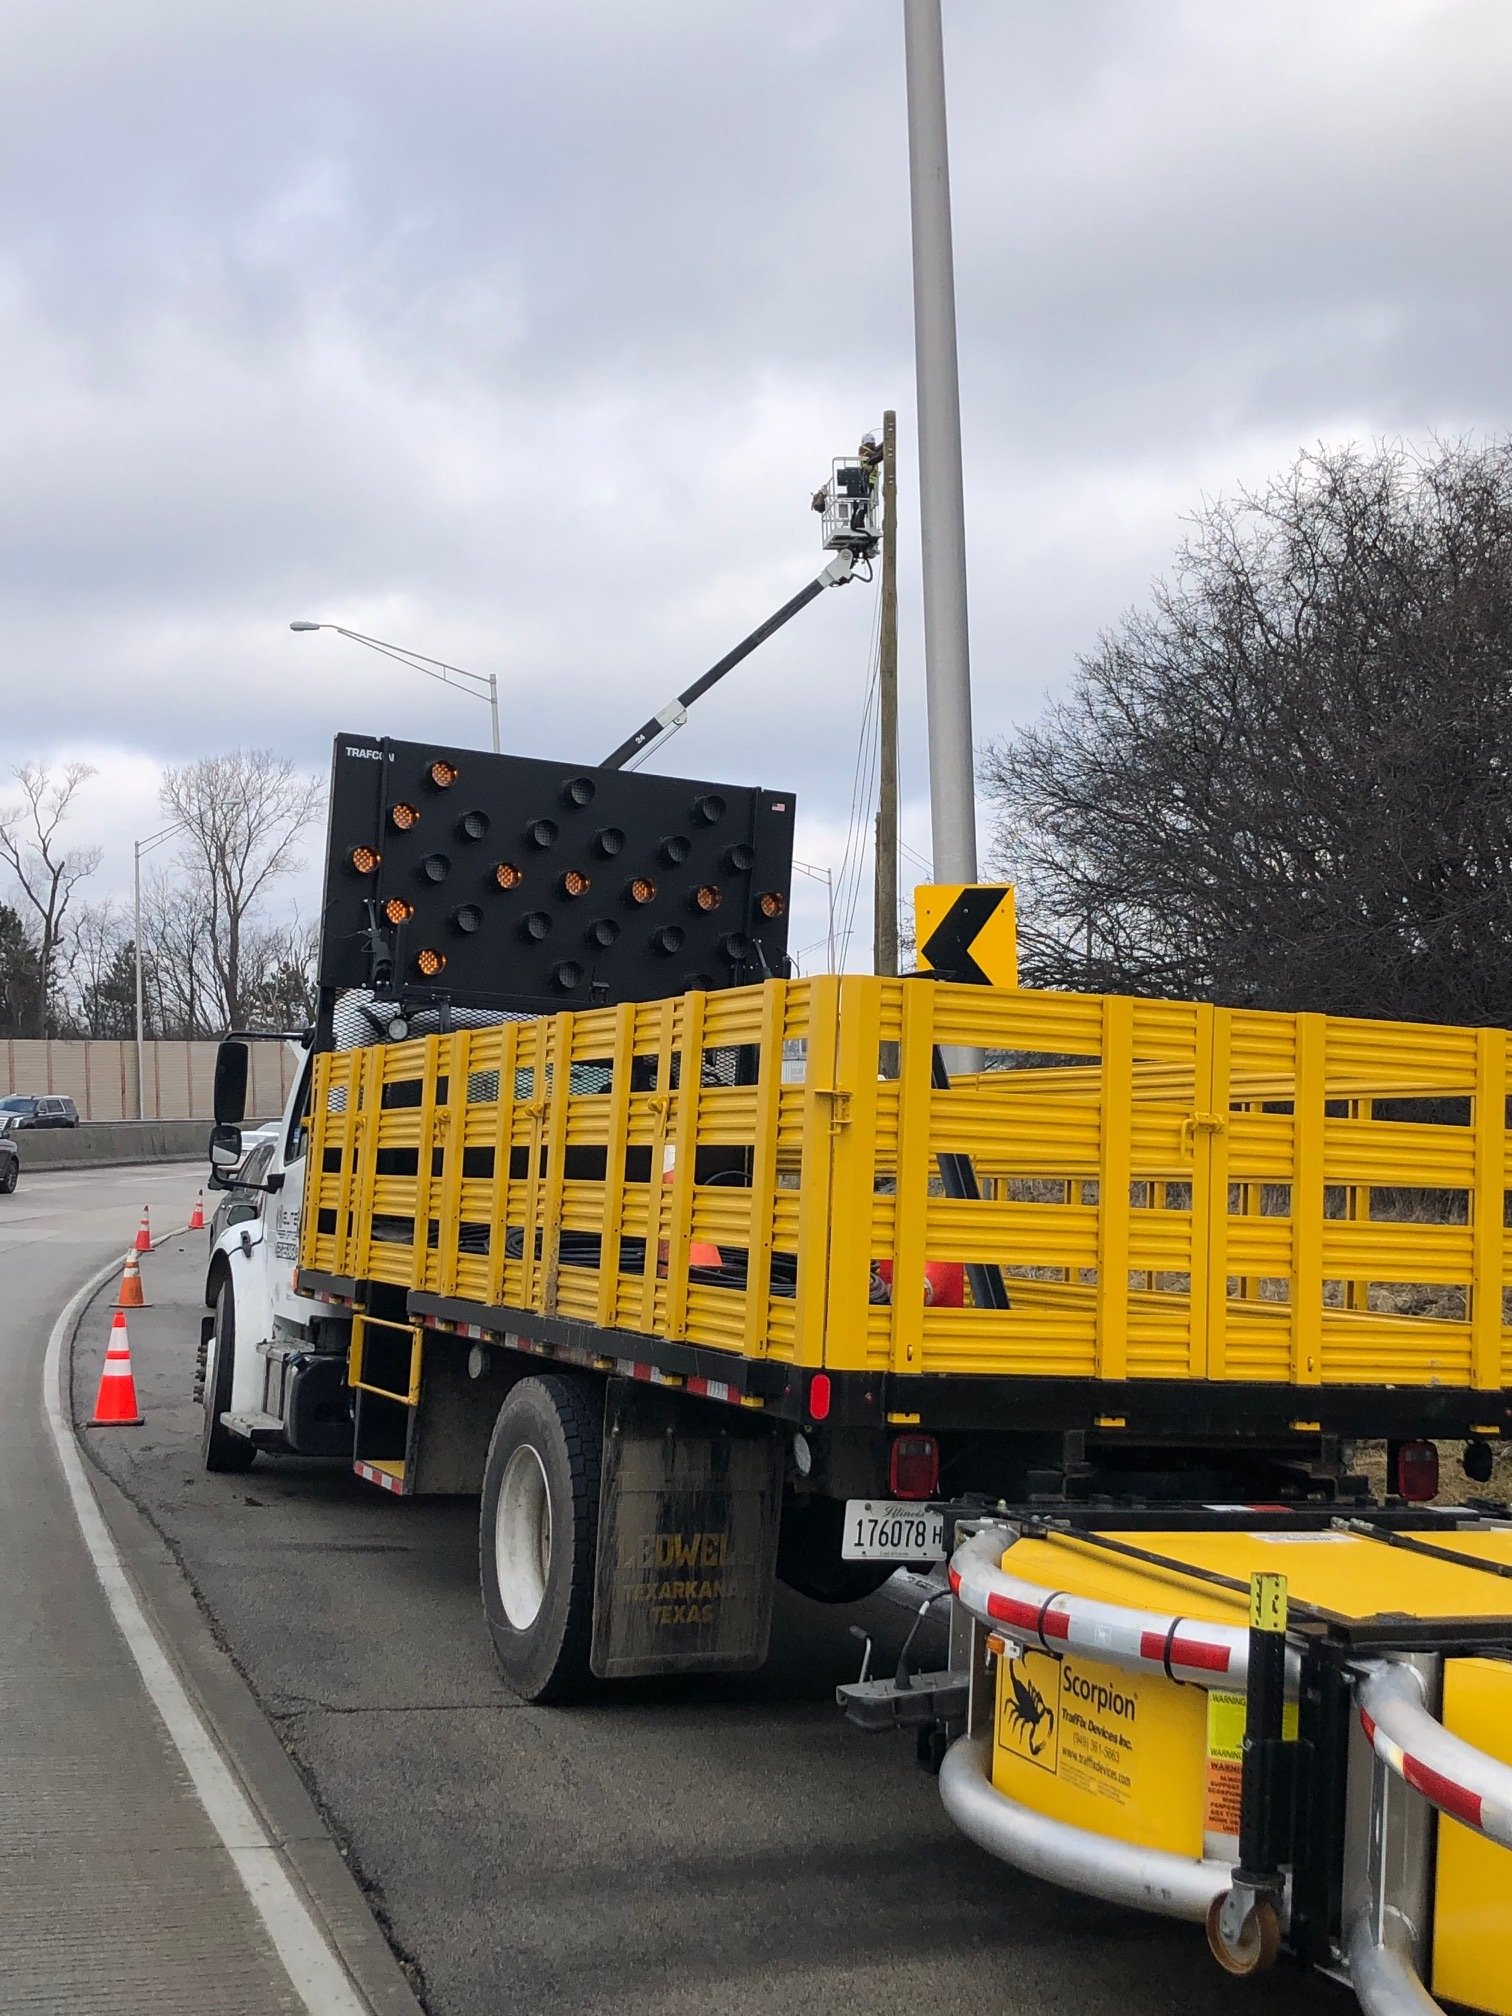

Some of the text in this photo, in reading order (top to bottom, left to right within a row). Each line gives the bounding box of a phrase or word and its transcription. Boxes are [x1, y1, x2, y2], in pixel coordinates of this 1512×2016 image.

[346, 747, 394, 762] TRAFCN
[883, 1505, 925, 1519] Illinois
[854, 1519, 942, 1547] 176078 H
[654, 1605, 714, 1625] TEXAS
[1063, 1665, 1135, 1721] Scorpion
[1212, 1694, 1246, 1706] WARNING
[1088, 1719, 1118, 1744] Devices
[1210, 1762, 1240, 1772] WARNI
